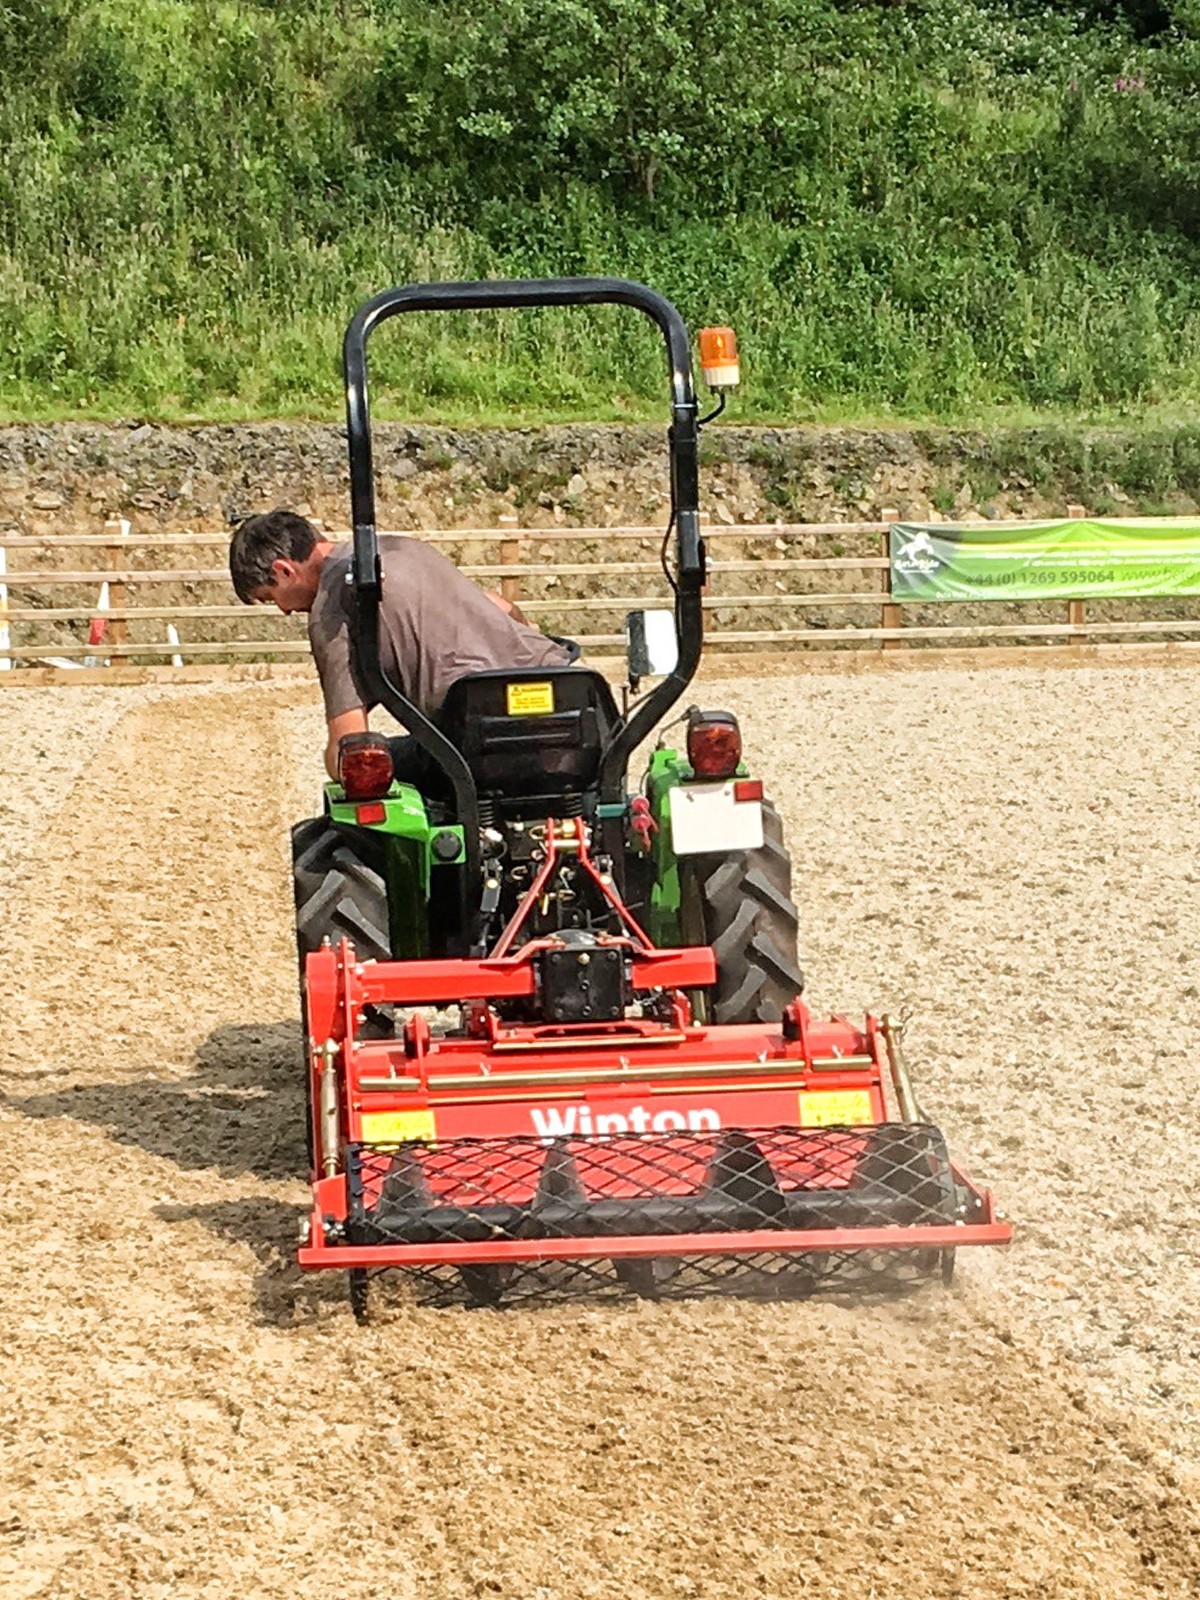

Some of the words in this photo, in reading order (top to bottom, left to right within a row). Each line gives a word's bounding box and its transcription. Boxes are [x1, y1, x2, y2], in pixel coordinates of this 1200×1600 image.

[965, 573, 993, 586] +44
[996, 572, 1016, 585] (0)
[1021, 571, 1056, 585] 1269
[1060, 570, 1115, 584] 595064
[530, 1105, 721, 1146] Winton
